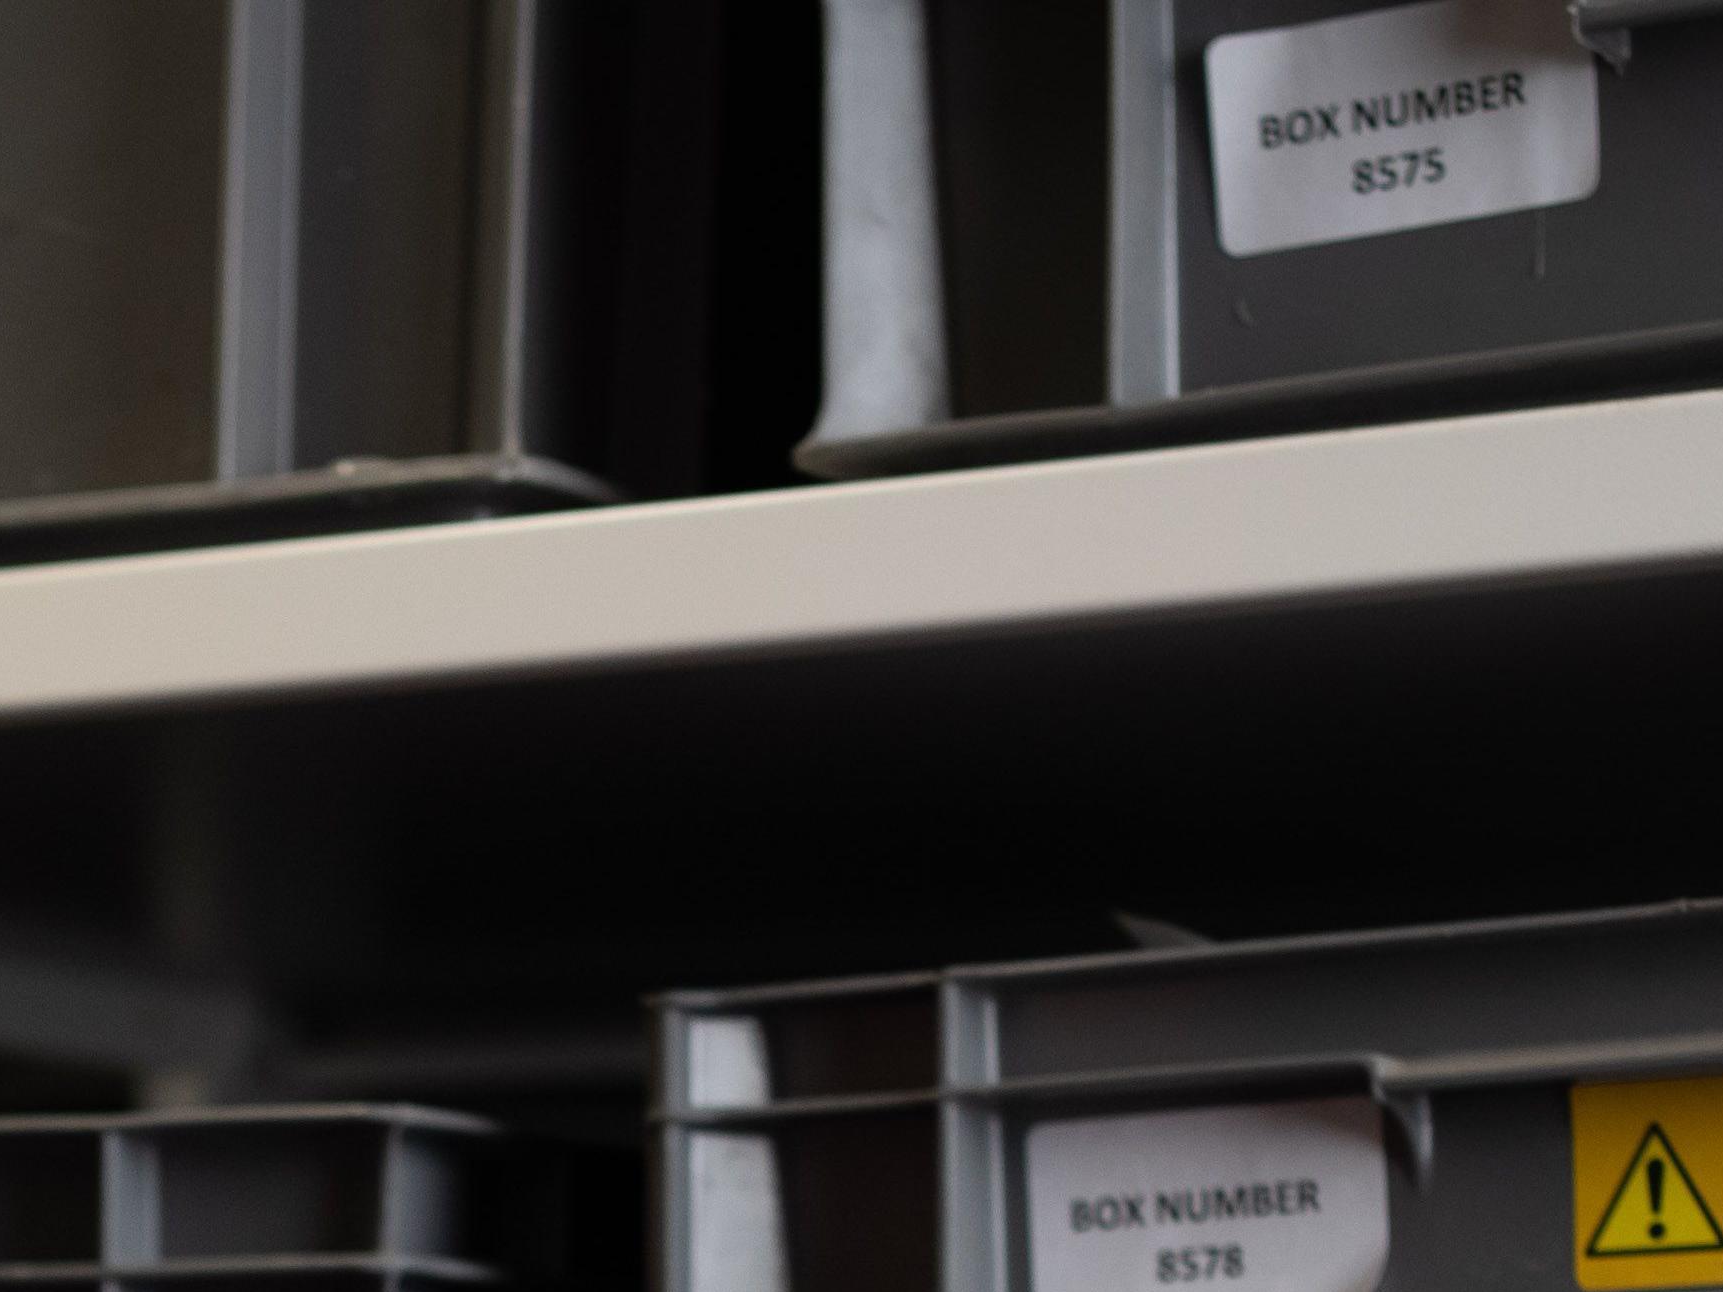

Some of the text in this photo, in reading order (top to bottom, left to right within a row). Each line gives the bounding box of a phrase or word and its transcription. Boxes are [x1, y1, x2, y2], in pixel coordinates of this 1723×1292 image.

[1258, 71, 1527, 149] BOX NUMBER
[1352, 148, 1447, 194] 8575
[1068, 1178, 1320, 1232] BOX NUMBER
[1155, 1245, 1245, 1284] 8578
